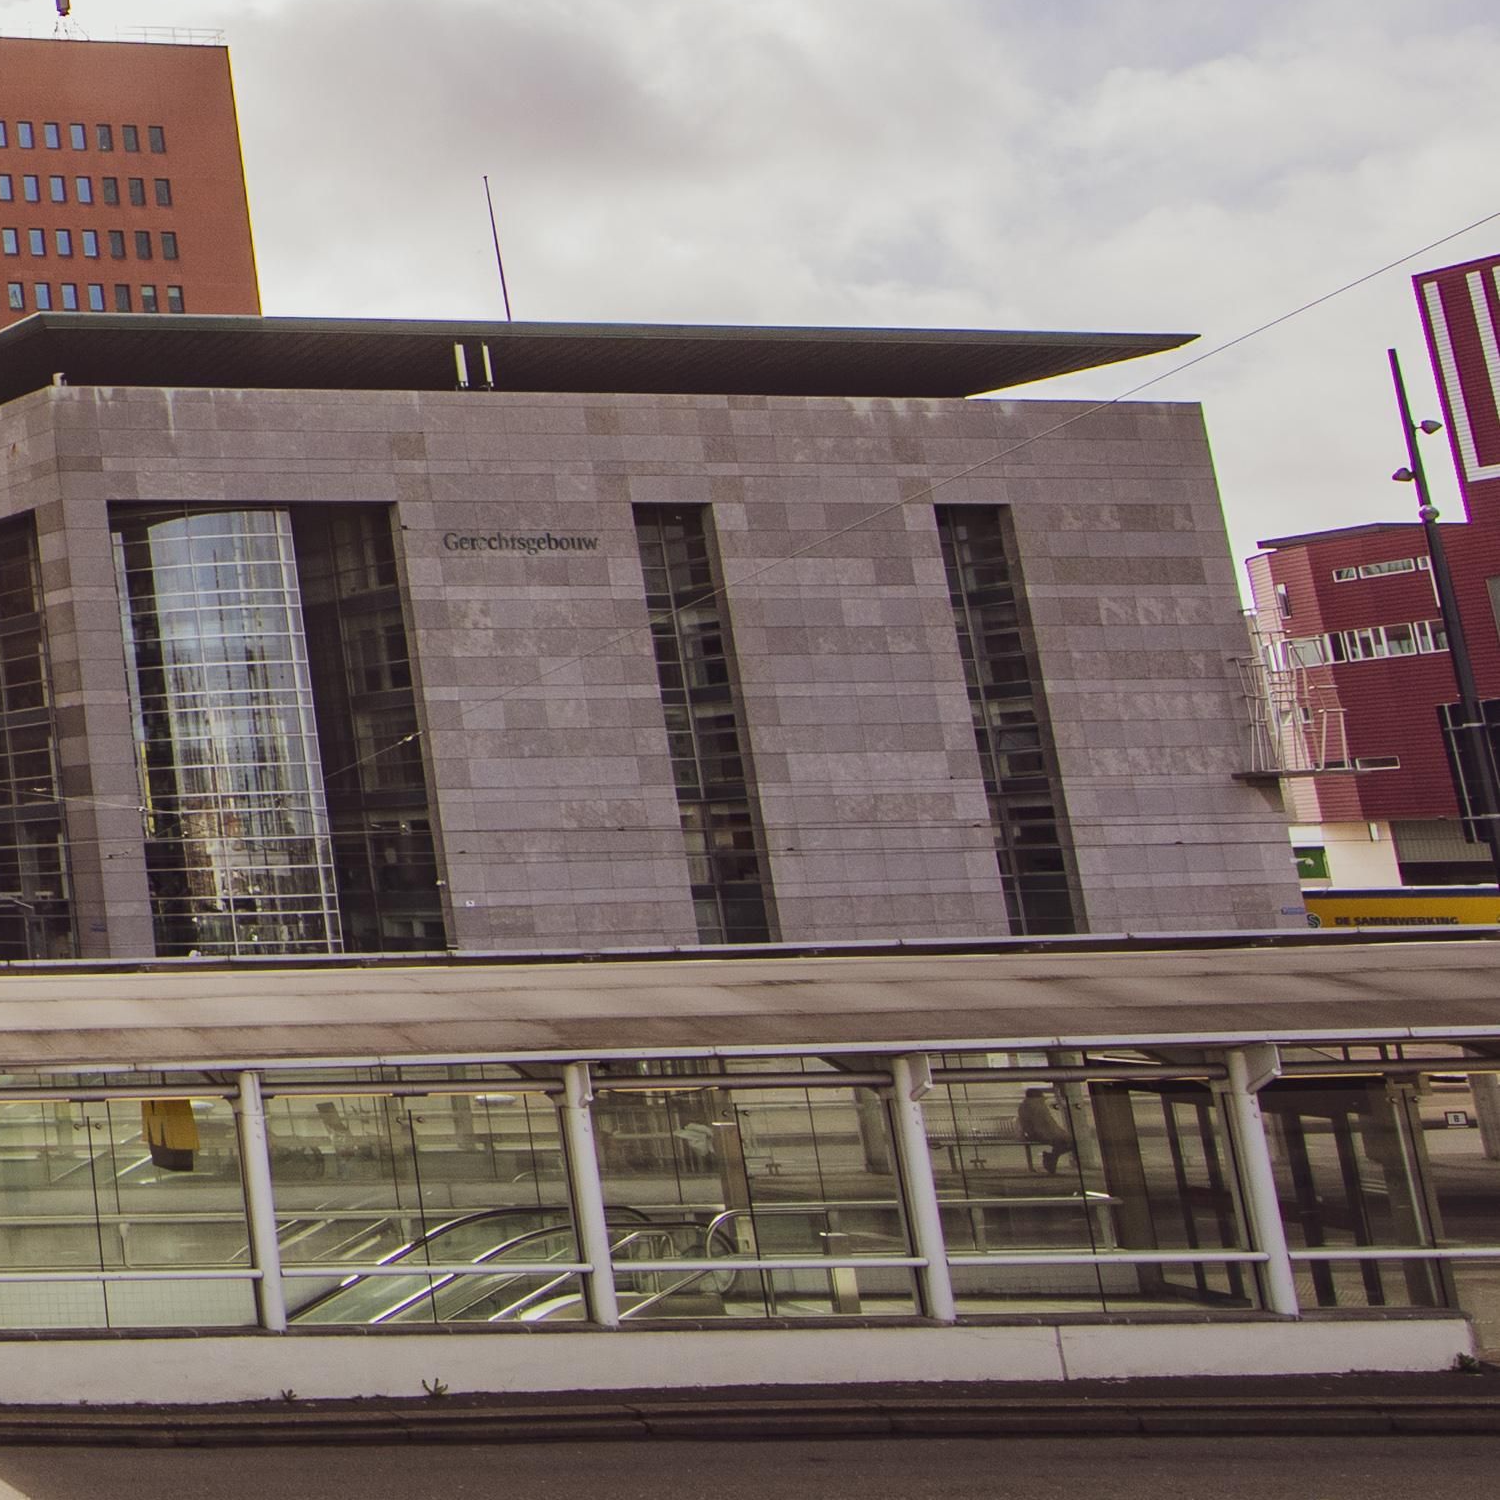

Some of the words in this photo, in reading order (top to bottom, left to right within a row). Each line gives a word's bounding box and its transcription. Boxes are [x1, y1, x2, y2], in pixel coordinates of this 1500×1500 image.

[443, 532, 598, 555] Gerechtsgebouw
[1335, 917, 1349, 926] DE
[1354, 916, 1459, 926] SAMENWERKING
